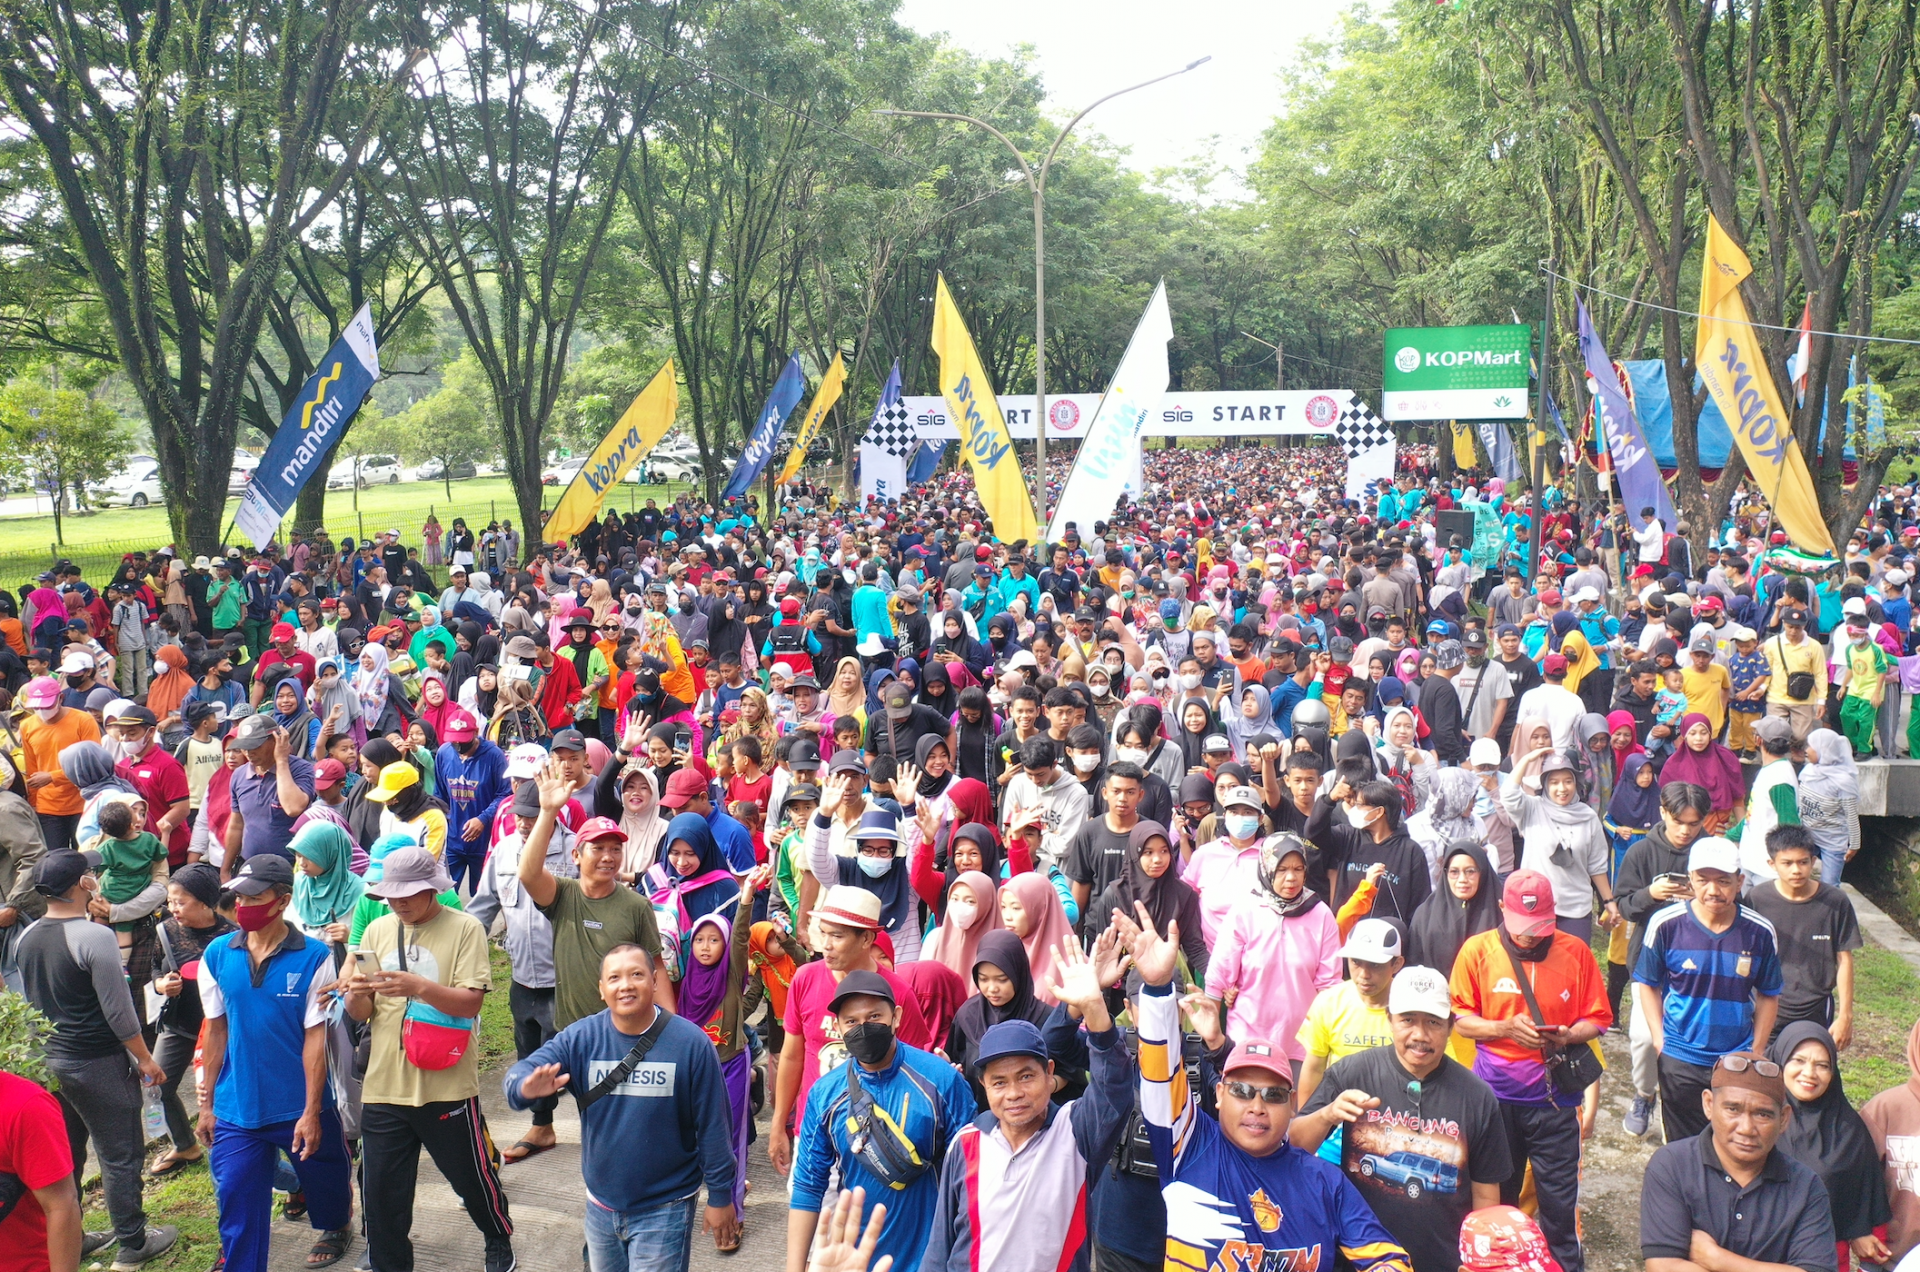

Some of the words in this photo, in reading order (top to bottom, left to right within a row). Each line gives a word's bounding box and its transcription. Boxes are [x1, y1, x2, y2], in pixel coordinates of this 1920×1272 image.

[1711, 255, 1730, 277] mandiri
[1425, 350, 1522, 367] KOPMart
[917, 414, 946, 426] SIG
[1162, 411, 1194, 422] SIG
[1212, 405, 1286, 421] START
[280, 395, 344, 487] mandiri
[744, 405, 782, 466] kopra
[583, 425, 643, 496] kopra
[595, 1069, 667, 1085] NMESIS
